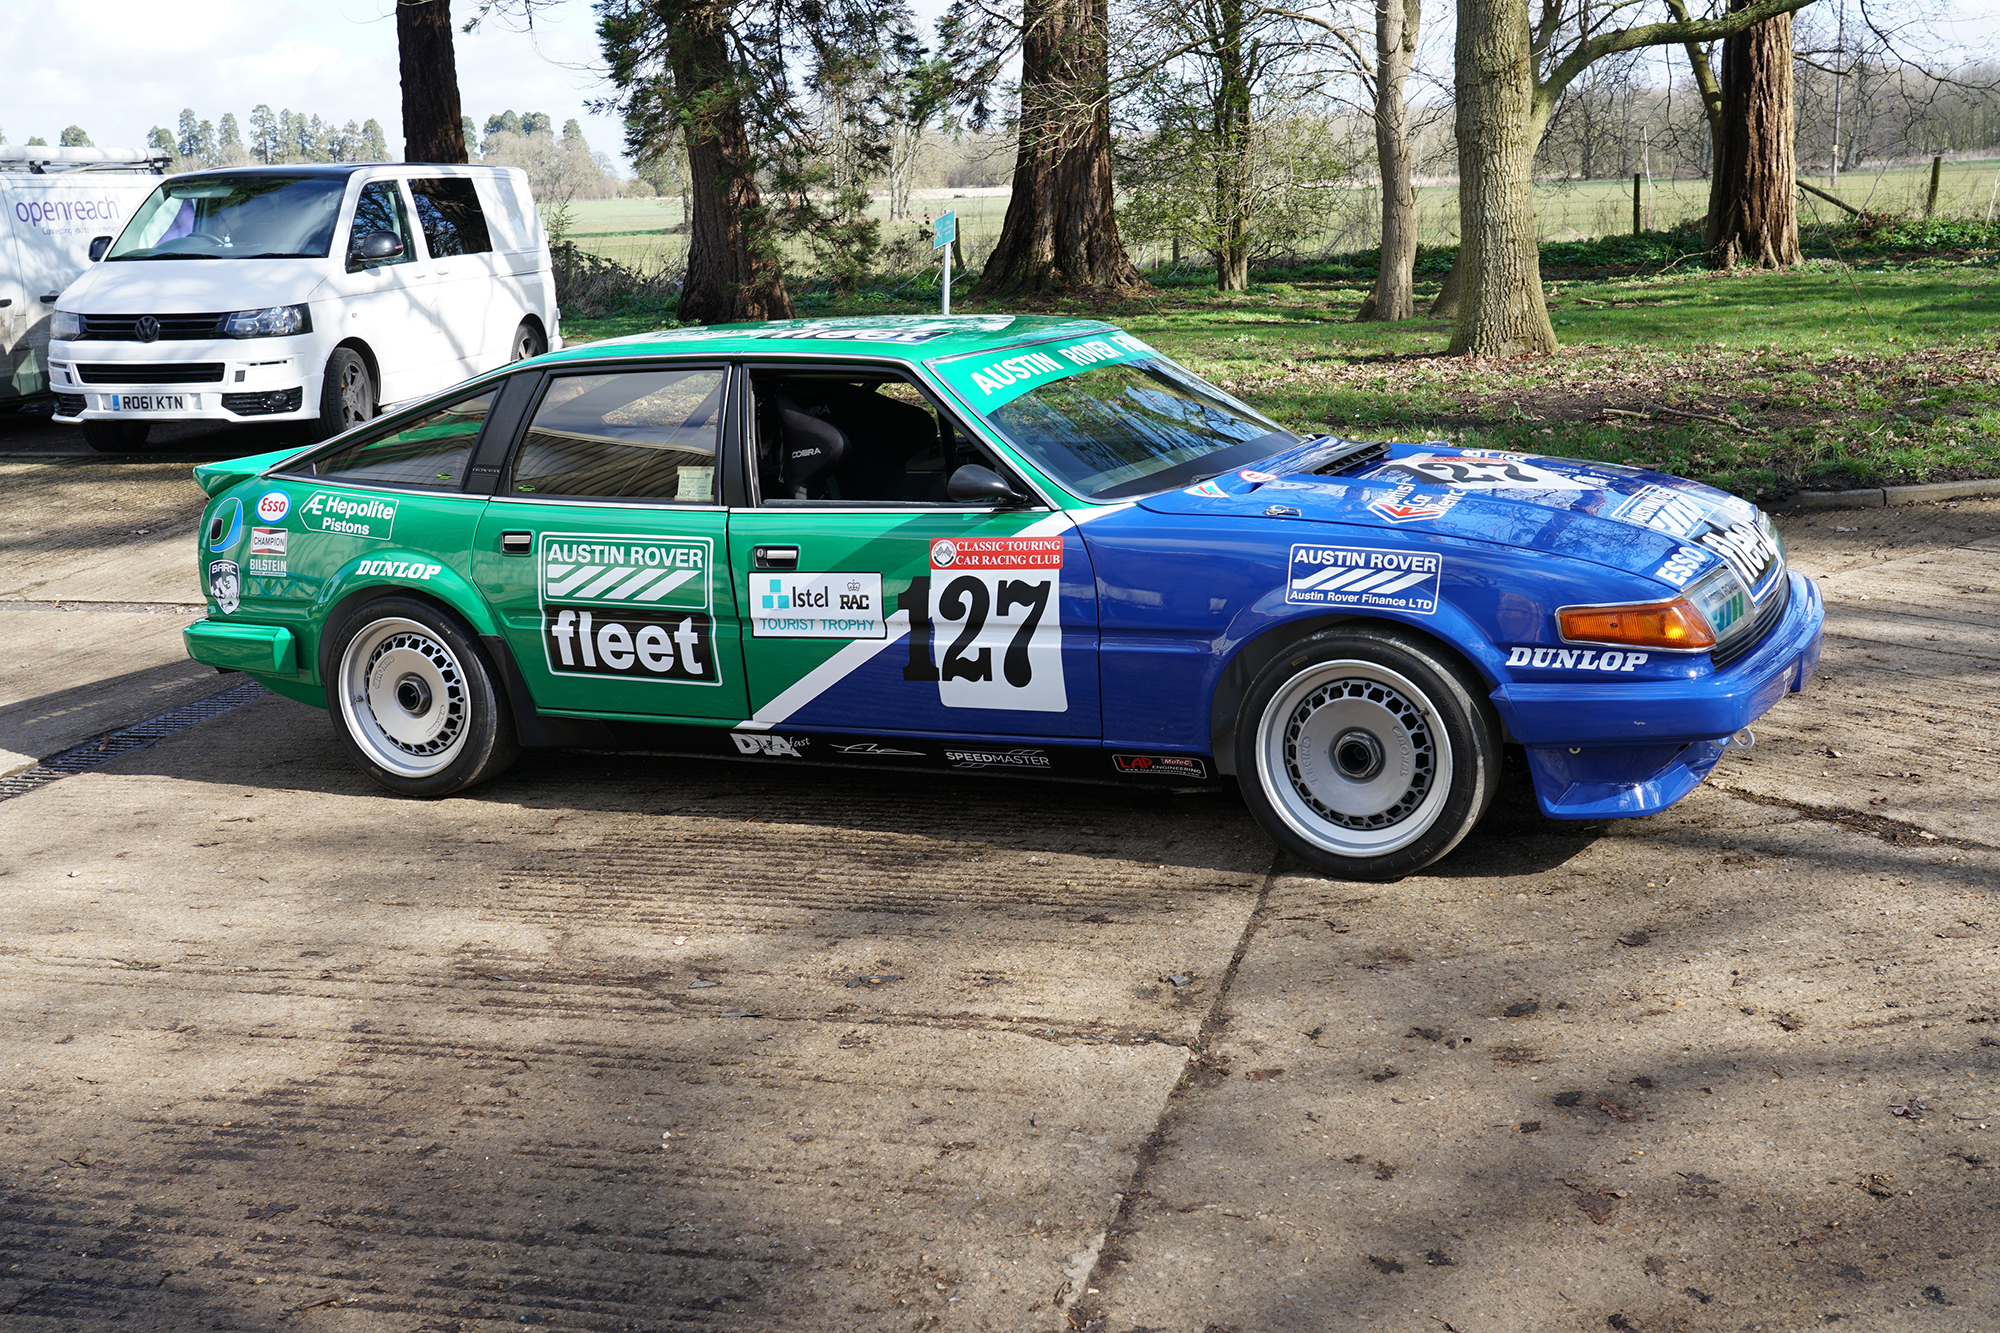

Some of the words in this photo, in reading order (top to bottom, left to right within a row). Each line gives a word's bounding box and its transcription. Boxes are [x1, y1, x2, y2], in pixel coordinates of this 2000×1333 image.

[16, 196, 120, 227] openreach
[970, 351, 1064, 396] AUSTIN
[1057, 341, 1125, 368] ROVER
[122, 396, 153, 410] RO61
[156, 396, 184, 410] KTN
[792, 447, 822, 459] COBRA
[325, 496, 394, 520] Hepolite
[322, 517, 370, 535] Pistons
[253, 536, 285, 547] CHAMPION
[956, 541, 1005, 551] CLASSIC
[1007, 540, 1061, 551] TOURING
[547, 544, 625, 564] AUSTIN
[630, 547, 703, 568] ROVER
[955, 555, 980, 566] CAR
[982, 555, 1027, 565] RACING
[1029, 554, 1061, 565] CLUB
[1294, 549, 1366, 567] AUSTIN
[1370, 553, 1437, 572] ROVER
[211, 563, 237, 575] BARC
[250, 559, 287, 572] BILSTEIN
[355, 560, 442, 580] DUNLOP
[1655, 547, 1706, 586] ESSO
[792, 586, 829, 608] Istel
[839, 594, 870, 610] RAC
[1290, 590, 1324, 602] Austin
[1327, 591, 1360, 604] Rover
[1361, 593, 1406, 607] Finance
[1408, 598, 1433, 610] LTD
[760, 617, 816, 631] TOURIST
[819, 618, 876, 631] TROPHY
[897, 575, 1052, 688] 127
[552, 610, 704, 675] fleet
[1505, 646, 1649, 672] DUNLOP
[788, 736, 811, 751] fast
[945, 752, 1050, 766] SPEEDMASTER
[1117, 756, 1153, 769] LAP
[1151, 764, 1202, 774] ENGINEERING
